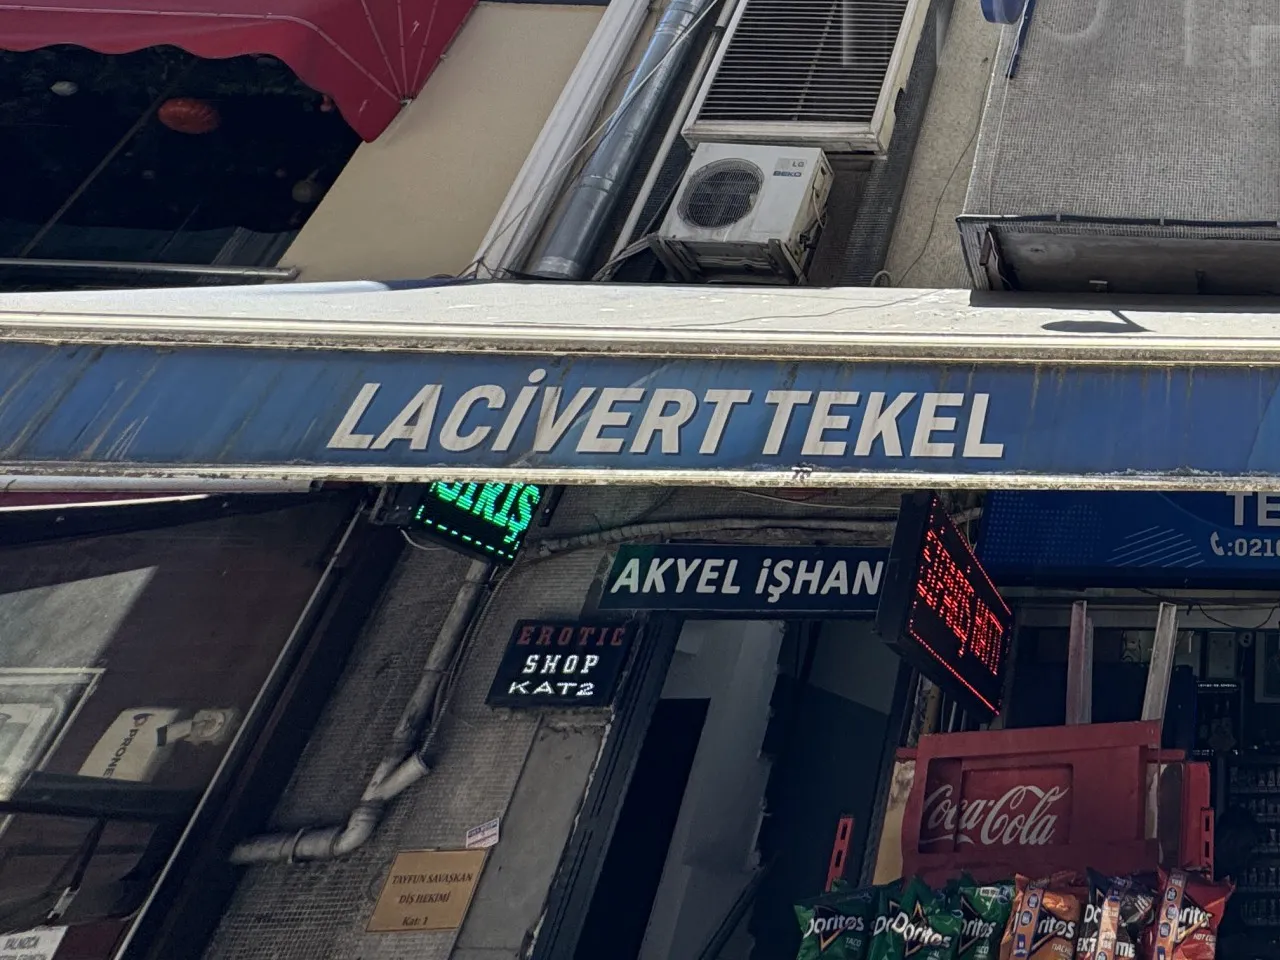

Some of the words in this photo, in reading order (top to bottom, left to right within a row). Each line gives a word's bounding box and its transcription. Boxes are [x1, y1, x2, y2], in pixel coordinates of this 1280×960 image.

[772, 170, 802, 178] BEKO
[326, 368, 751, 456] LACİVERT
[764, 389, 1004, 458] TEKEL
[610, 558, 741, 594] AKYEL
[516, 625, 626, 646] EROTIC
[522, 654, 600, 674] SHOP
[103, 729, 139, 777] PRONE
[921, 784, 1070, 846] Coca-Cola
[392, 874, 426, 885] TAYFUN
[422, 916, 429, 926] 1
[891, 912, 952, 948] Doritos
[961, 918, 997, 938] ritos
[1037, 916, 1076, 940] ritos
